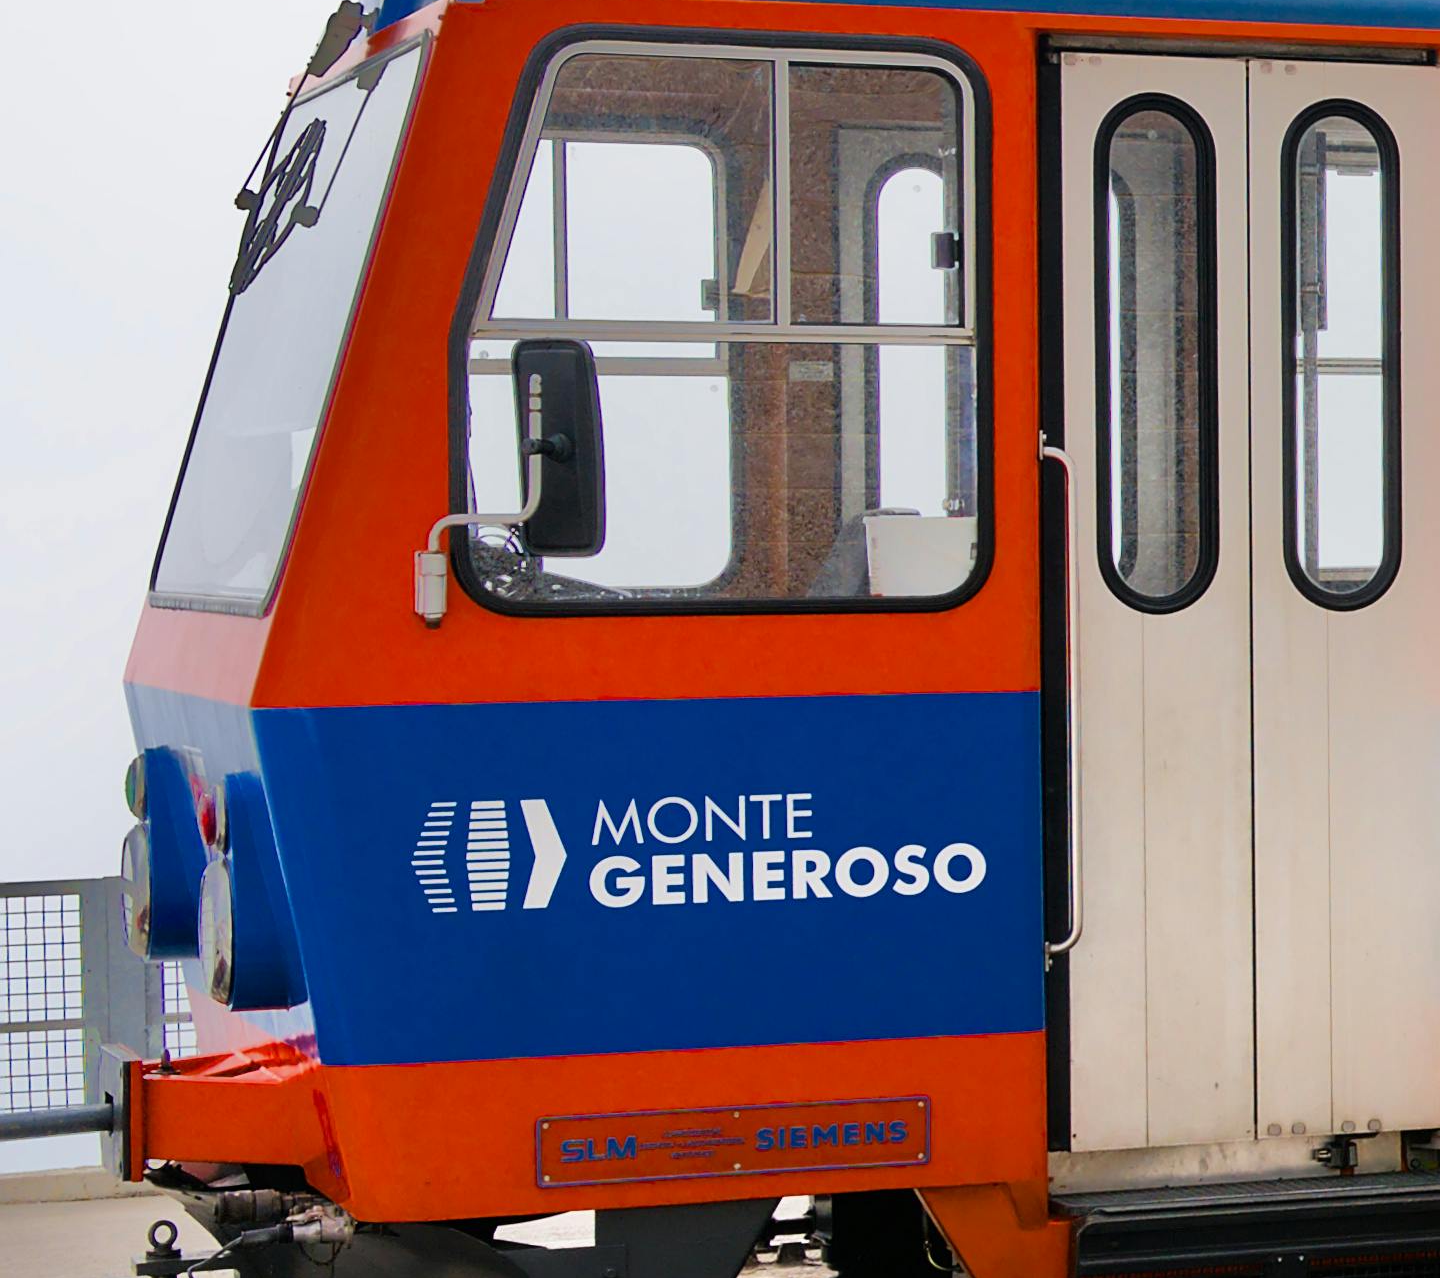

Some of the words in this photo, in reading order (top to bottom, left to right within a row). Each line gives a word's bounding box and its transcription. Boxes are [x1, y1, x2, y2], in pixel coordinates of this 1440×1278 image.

[591, 793, 813, 846] MONTE
[589, 843, 987, 908] GENEROSO
[560, 1135, 637, 1163] SLM
[755, 1120, 908, 1150] SIEMENS
